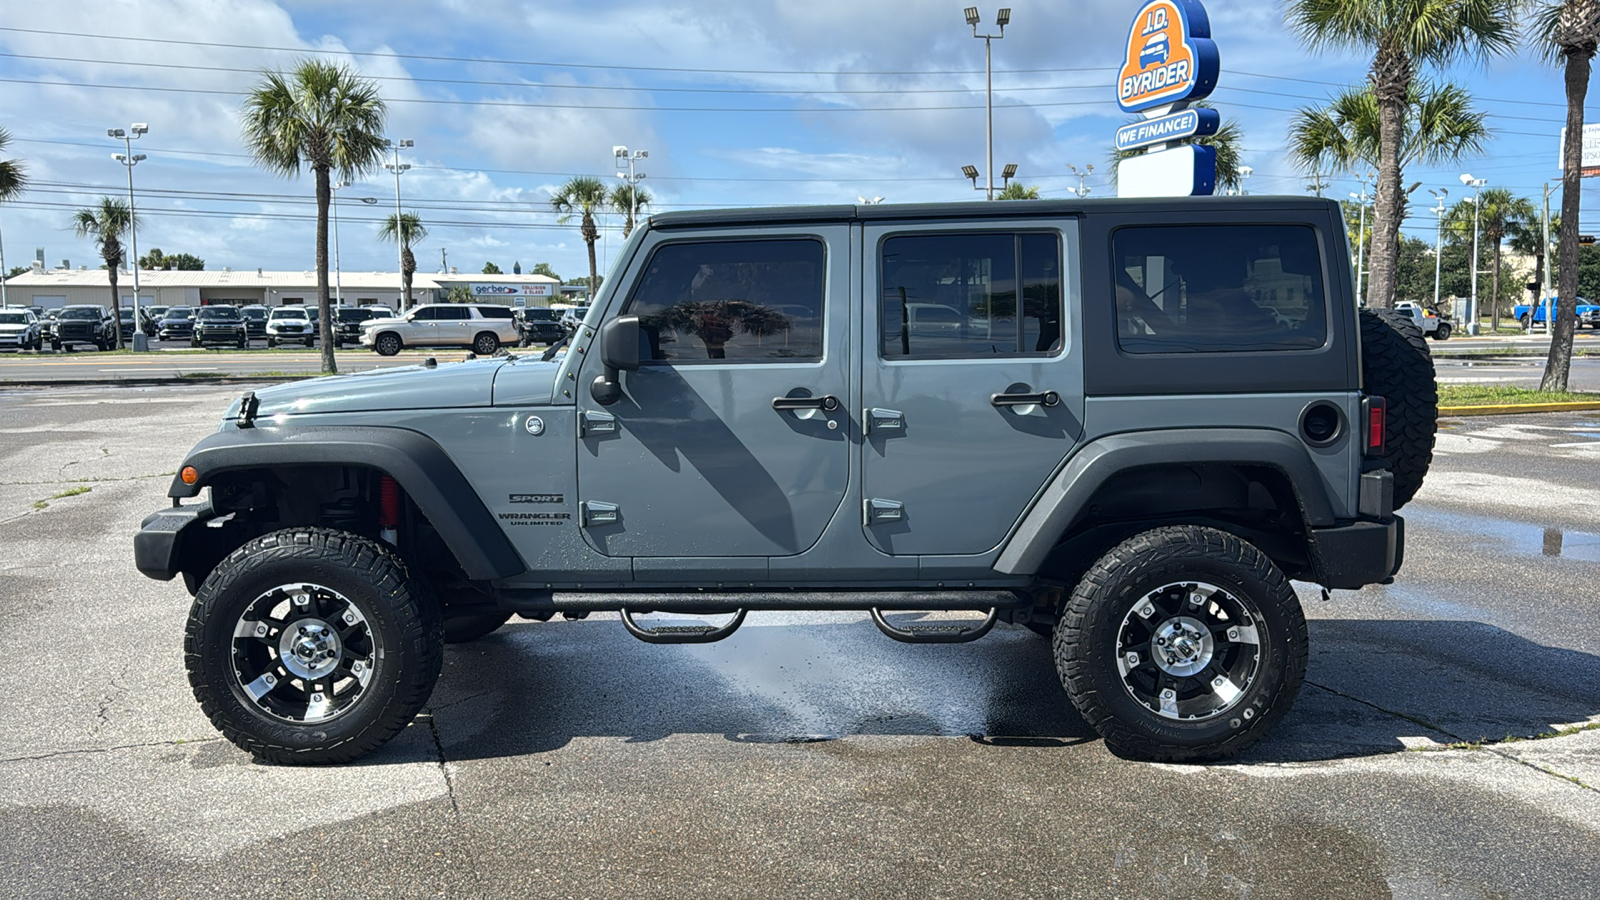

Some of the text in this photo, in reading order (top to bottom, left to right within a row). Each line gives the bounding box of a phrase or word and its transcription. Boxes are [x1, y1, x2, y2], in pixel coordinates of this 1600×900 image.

[1142, 7, 1169, 36] J.D.
[1121, 59, 1189, 99] BYRIDER
[1119, 115, 1193, 145] WE FINANCE!
[476, 285, 508, 294] gerber
[512, 494, 561, 502] SPORT
